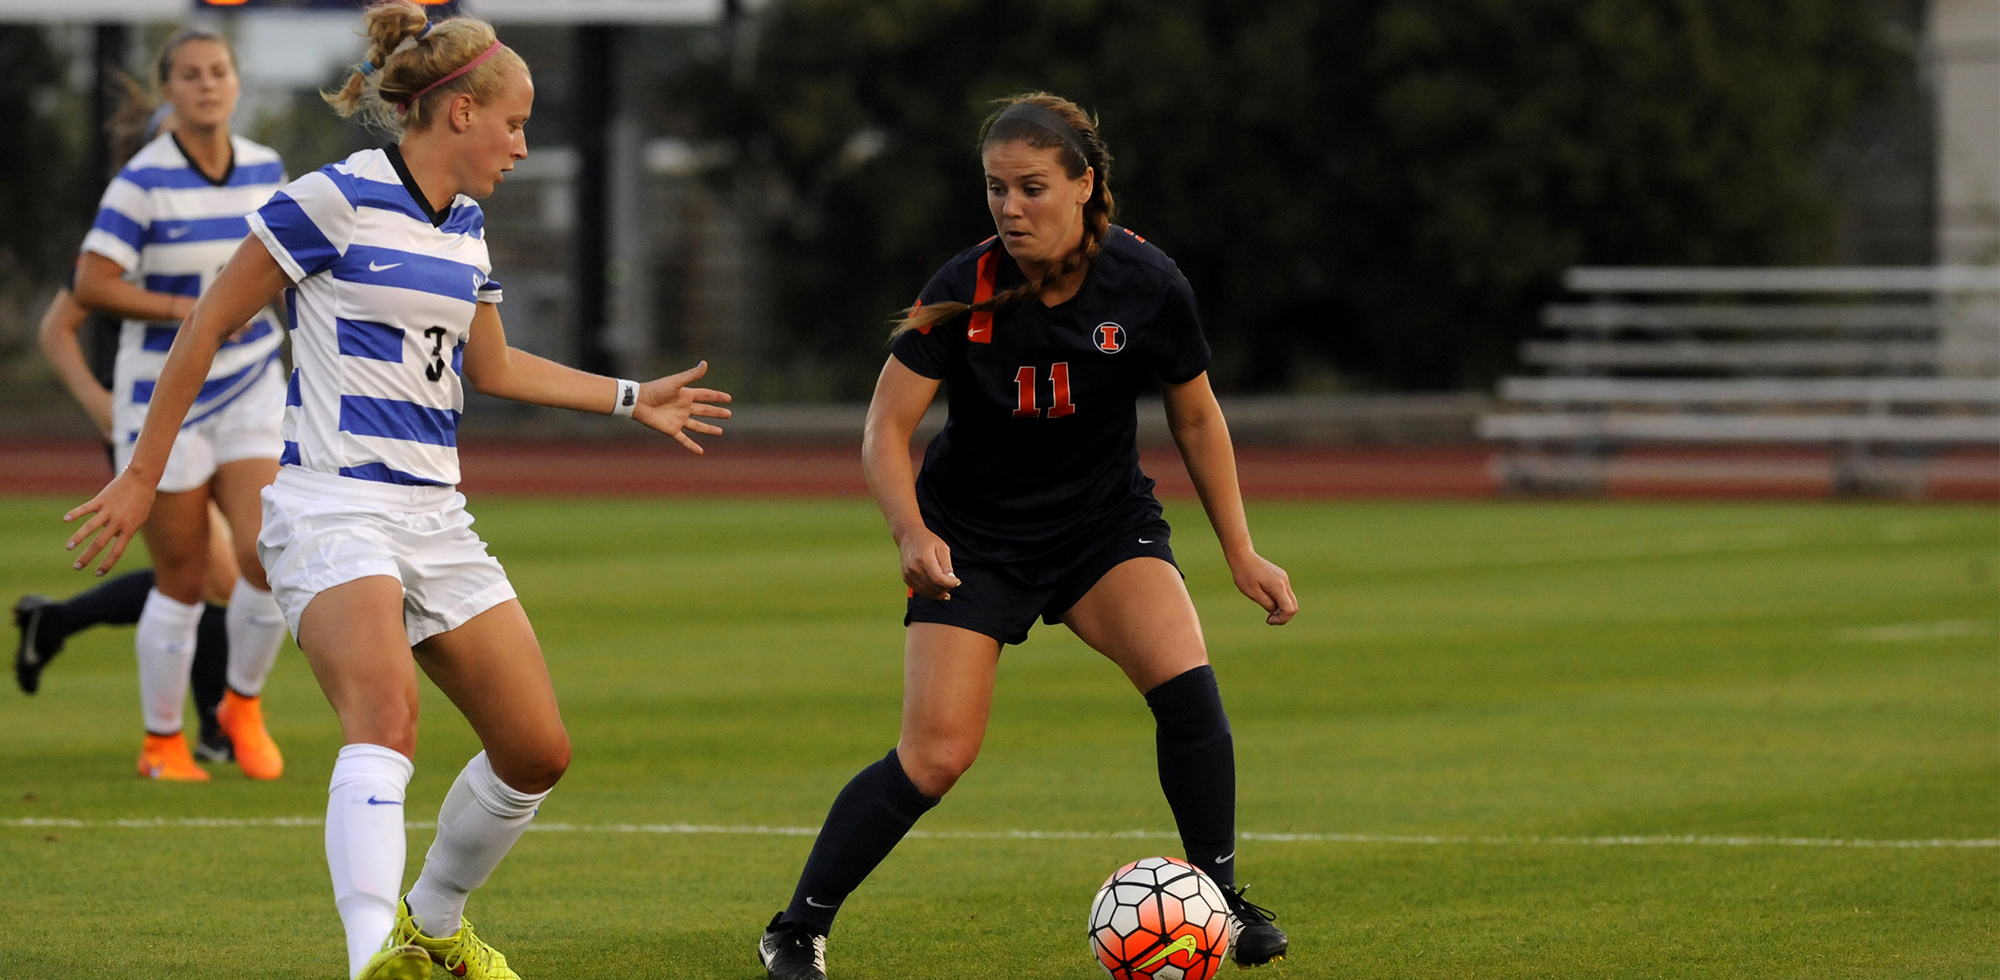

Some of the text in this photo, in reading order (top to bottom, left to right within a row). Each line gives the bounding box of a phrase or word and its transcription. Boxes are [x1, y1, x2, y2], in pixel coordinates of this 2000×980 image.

[424, 326, 446, 382] 3
[1100, 325, 1119, 350] I
[1012, 361, 1076, 418] 11
